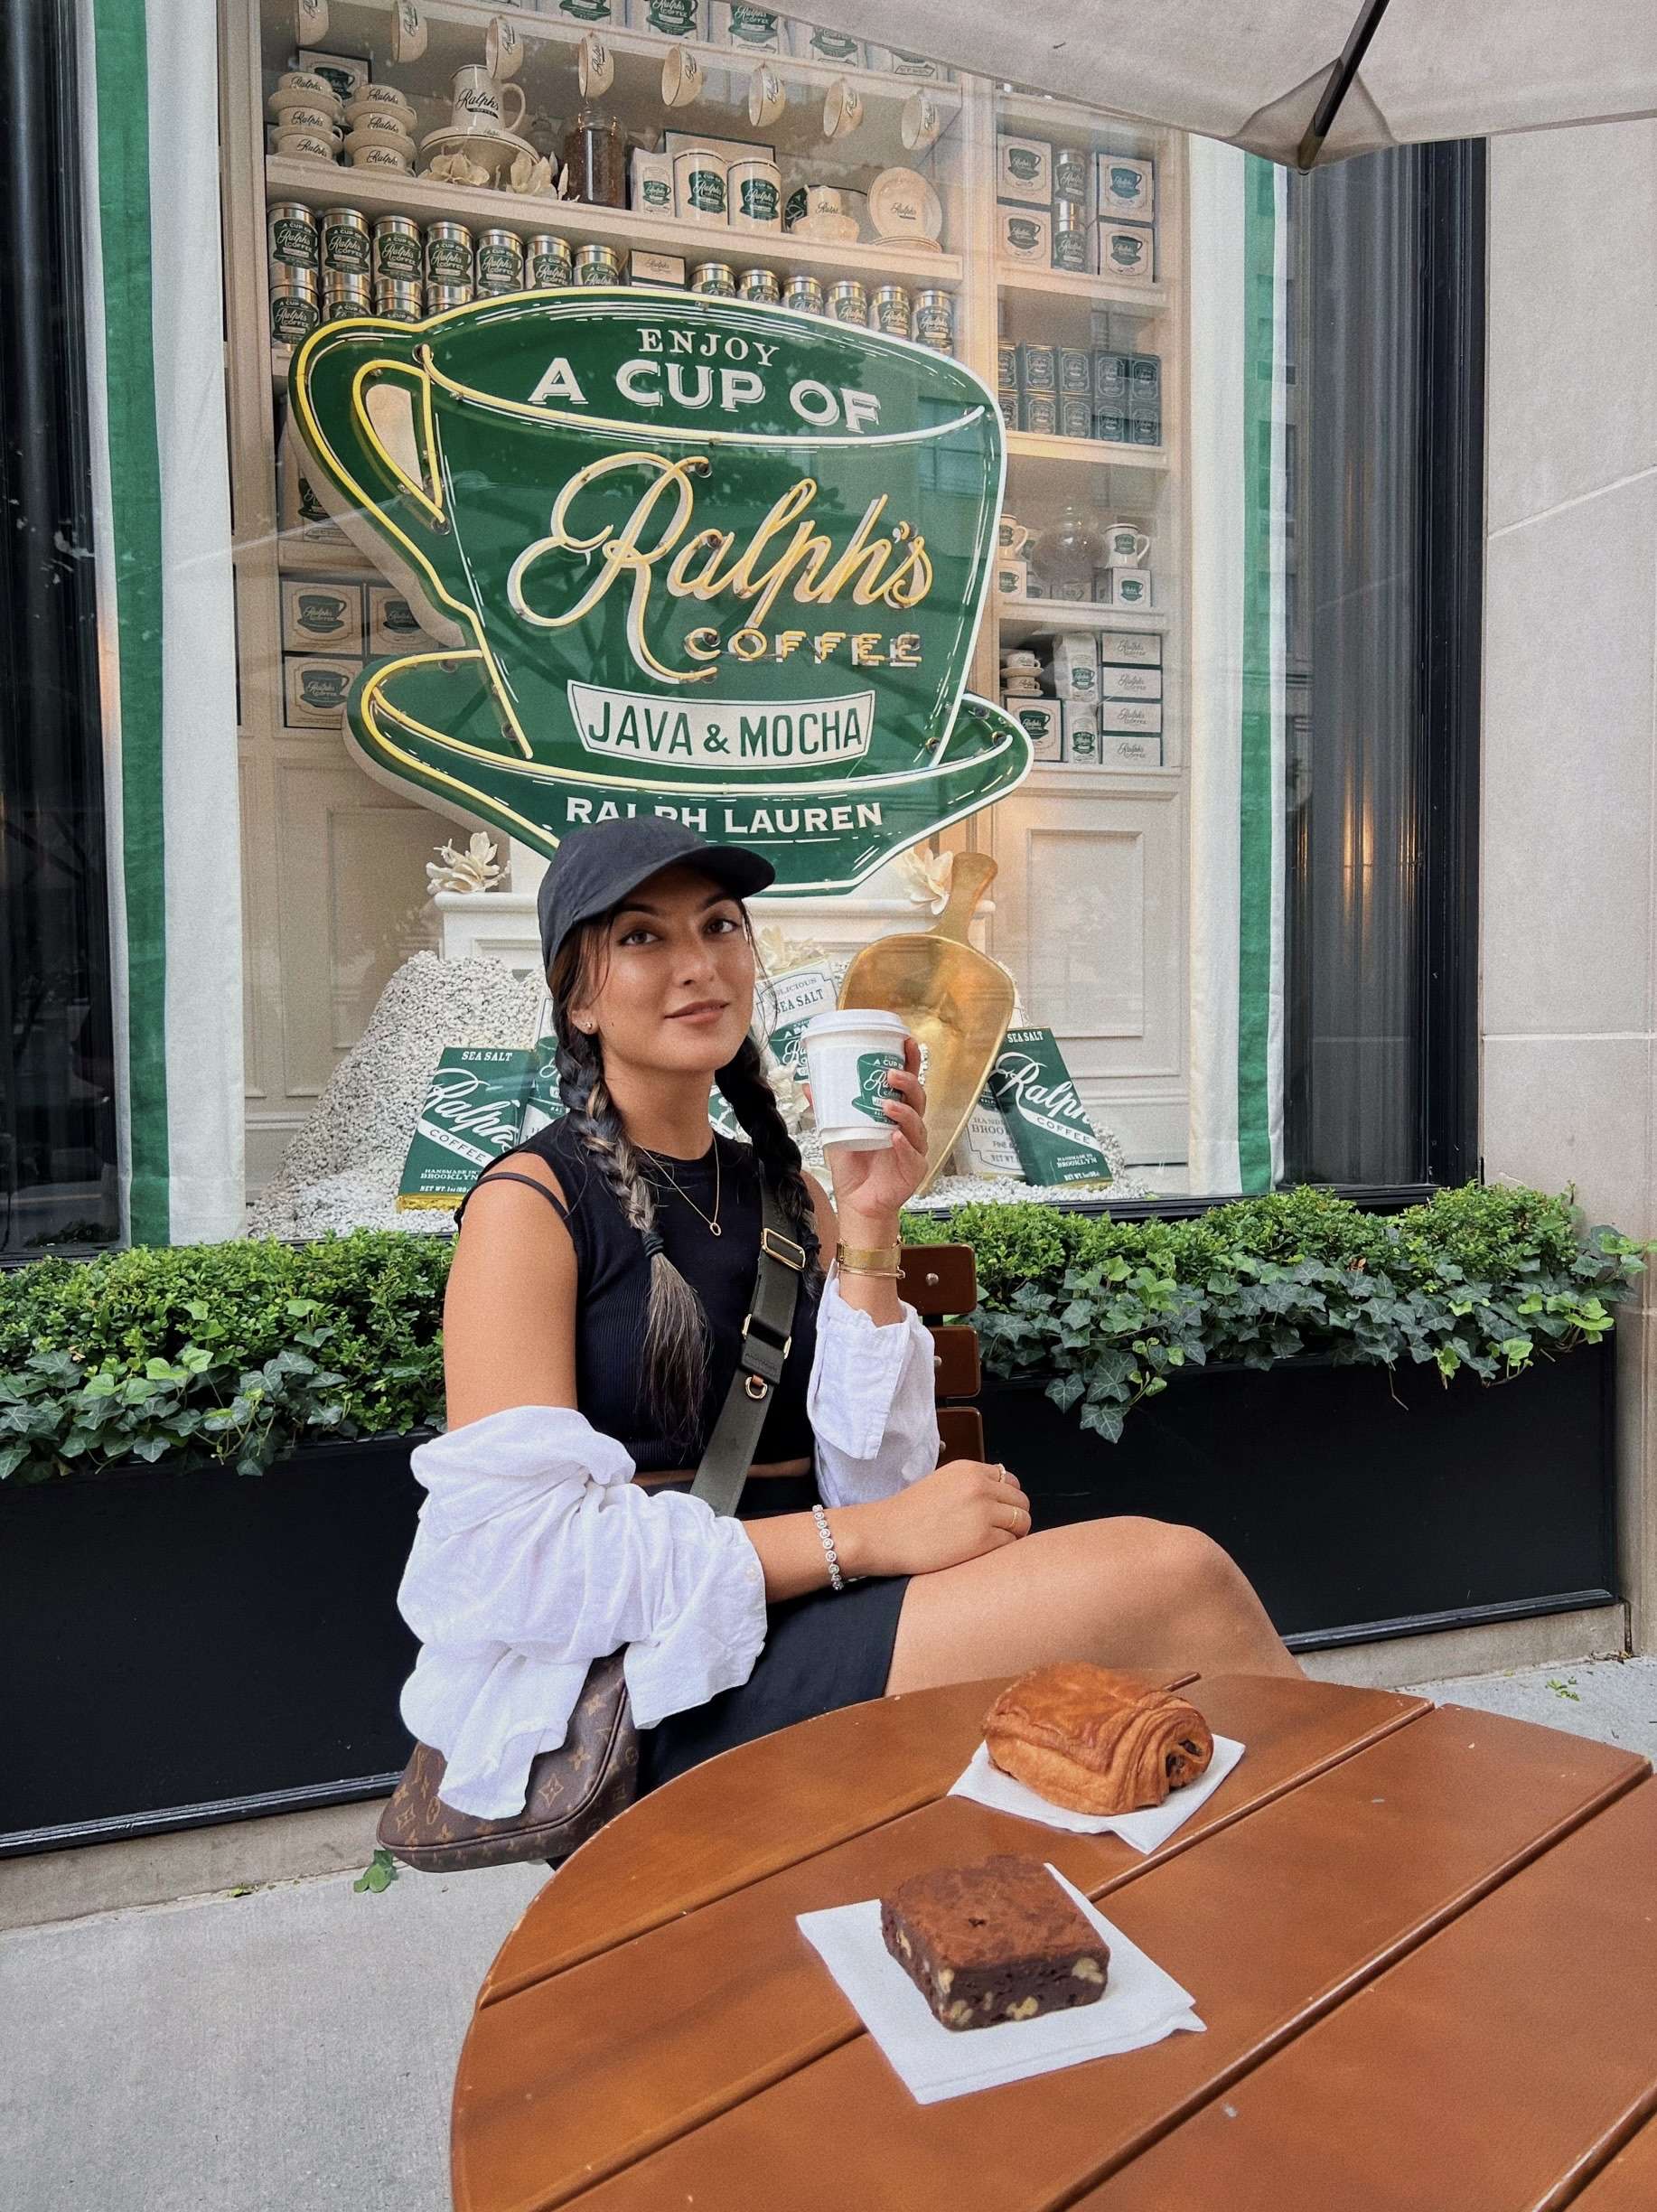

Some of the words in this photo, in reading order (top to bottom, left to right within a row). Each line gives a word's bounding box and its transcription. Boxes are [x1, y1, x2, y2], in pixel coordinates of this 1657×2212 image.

[340, 228, 352, 236] CUP
[637, 328, 780, 367] ENJOY
[528, 357, 589, 405] A
[615, 359, 766, 413] CUP
[789, 379, 881, 433] OF
[507, 451, 932, 684] Ralph's
[683, 626, 922, 669] COFFEE
[588, 702, 693, 755] JAVA
[703, 724, 730, 755] &
[740, 708, 863, 757] MOCHA
[724, 802, 884, 833] LAUREN
[796, 989, 824, 1007] SALT
[784, 1031, 793, 1040] A
[1007, 1032, 1024, 1043] SEA
[1024, 1031, 1044, 1042] SALT
[462, 1051, 482, 1061] SEA
[483, 1051, 513, 1062] SALT
[883, 1059, 898, 1068] CUP
[971, 1124, 1006, 1135] BROO
[1035, 1117, 1091, 1146] COFFEE
[429, 1129, 487, 1163] COFFEE
